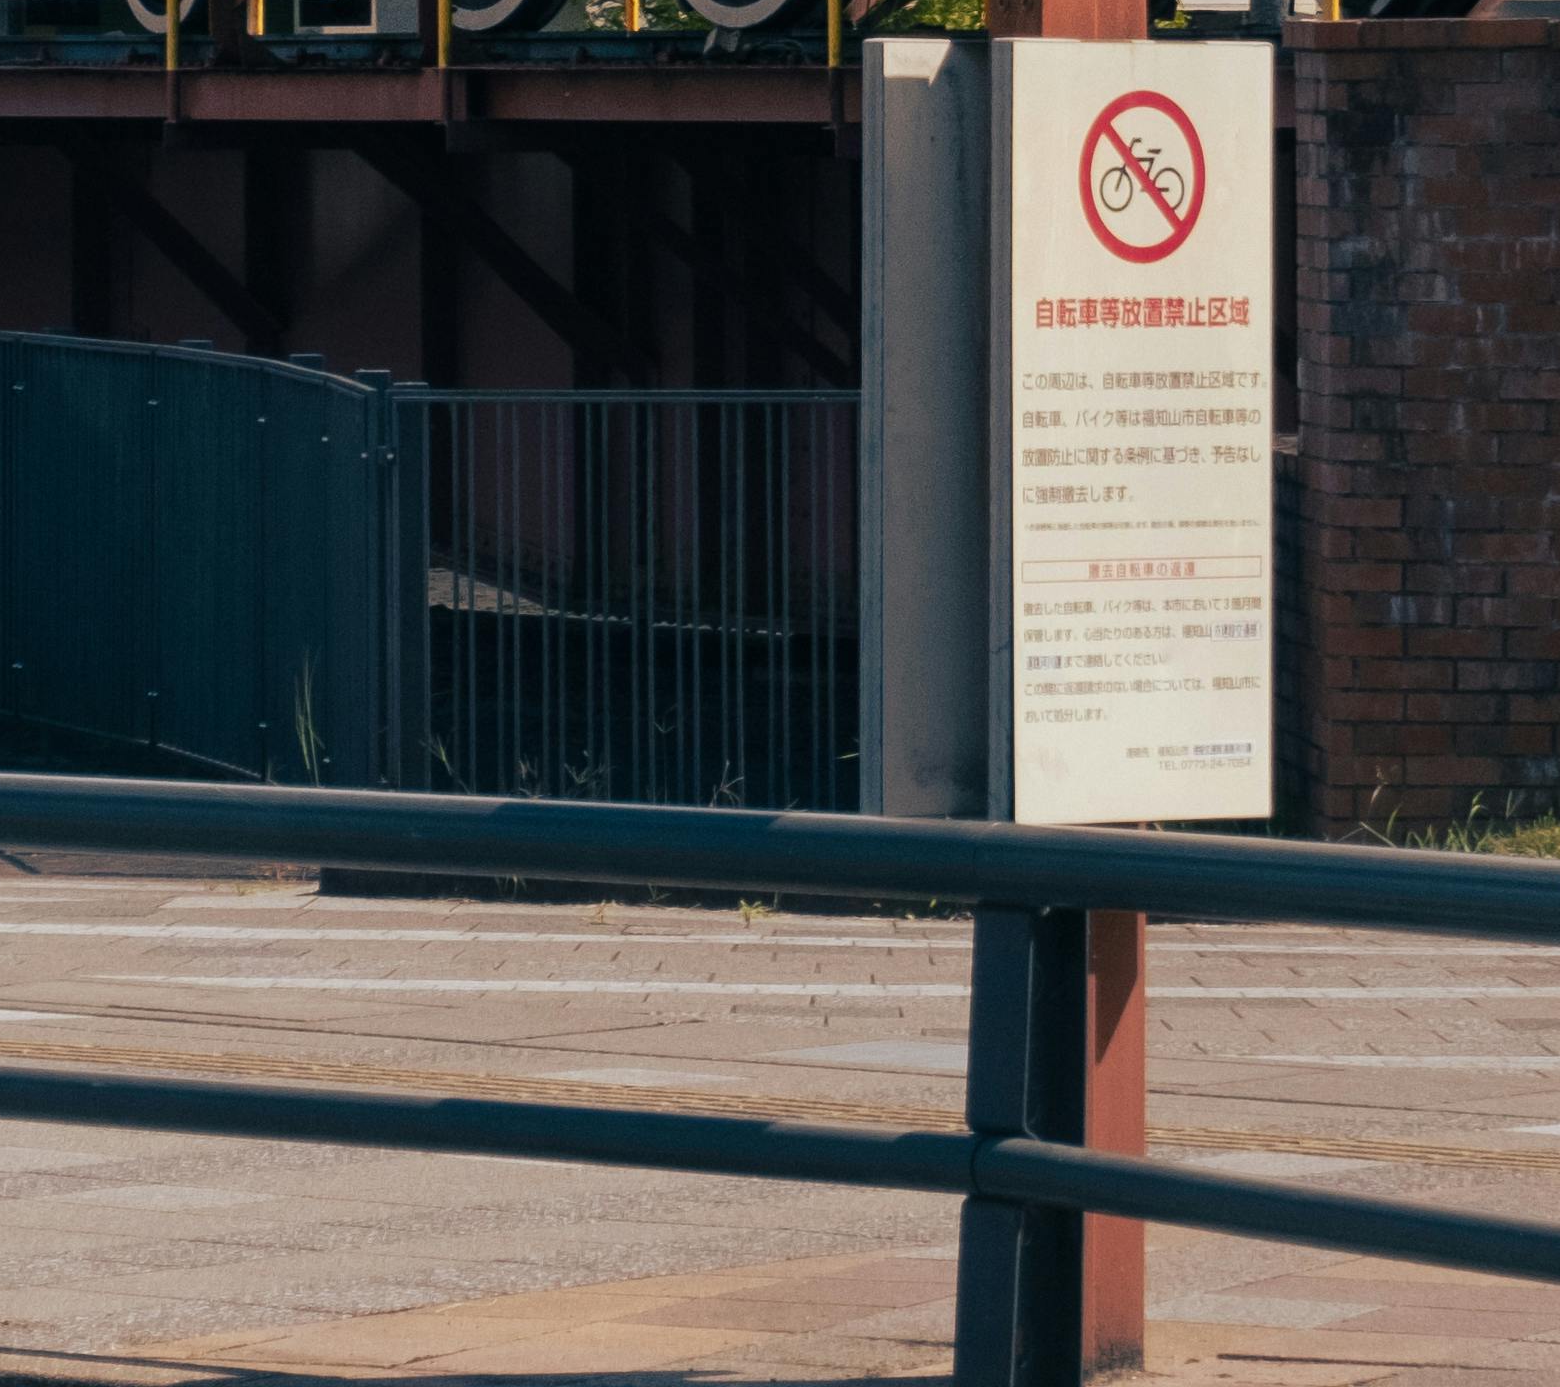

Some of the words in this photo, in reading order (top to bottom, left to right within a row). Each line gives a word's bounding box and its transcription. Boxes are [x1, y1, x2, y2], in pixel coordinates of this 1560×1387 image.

[1035, 296, 1250, 328] 自転車等放置禁止区域
